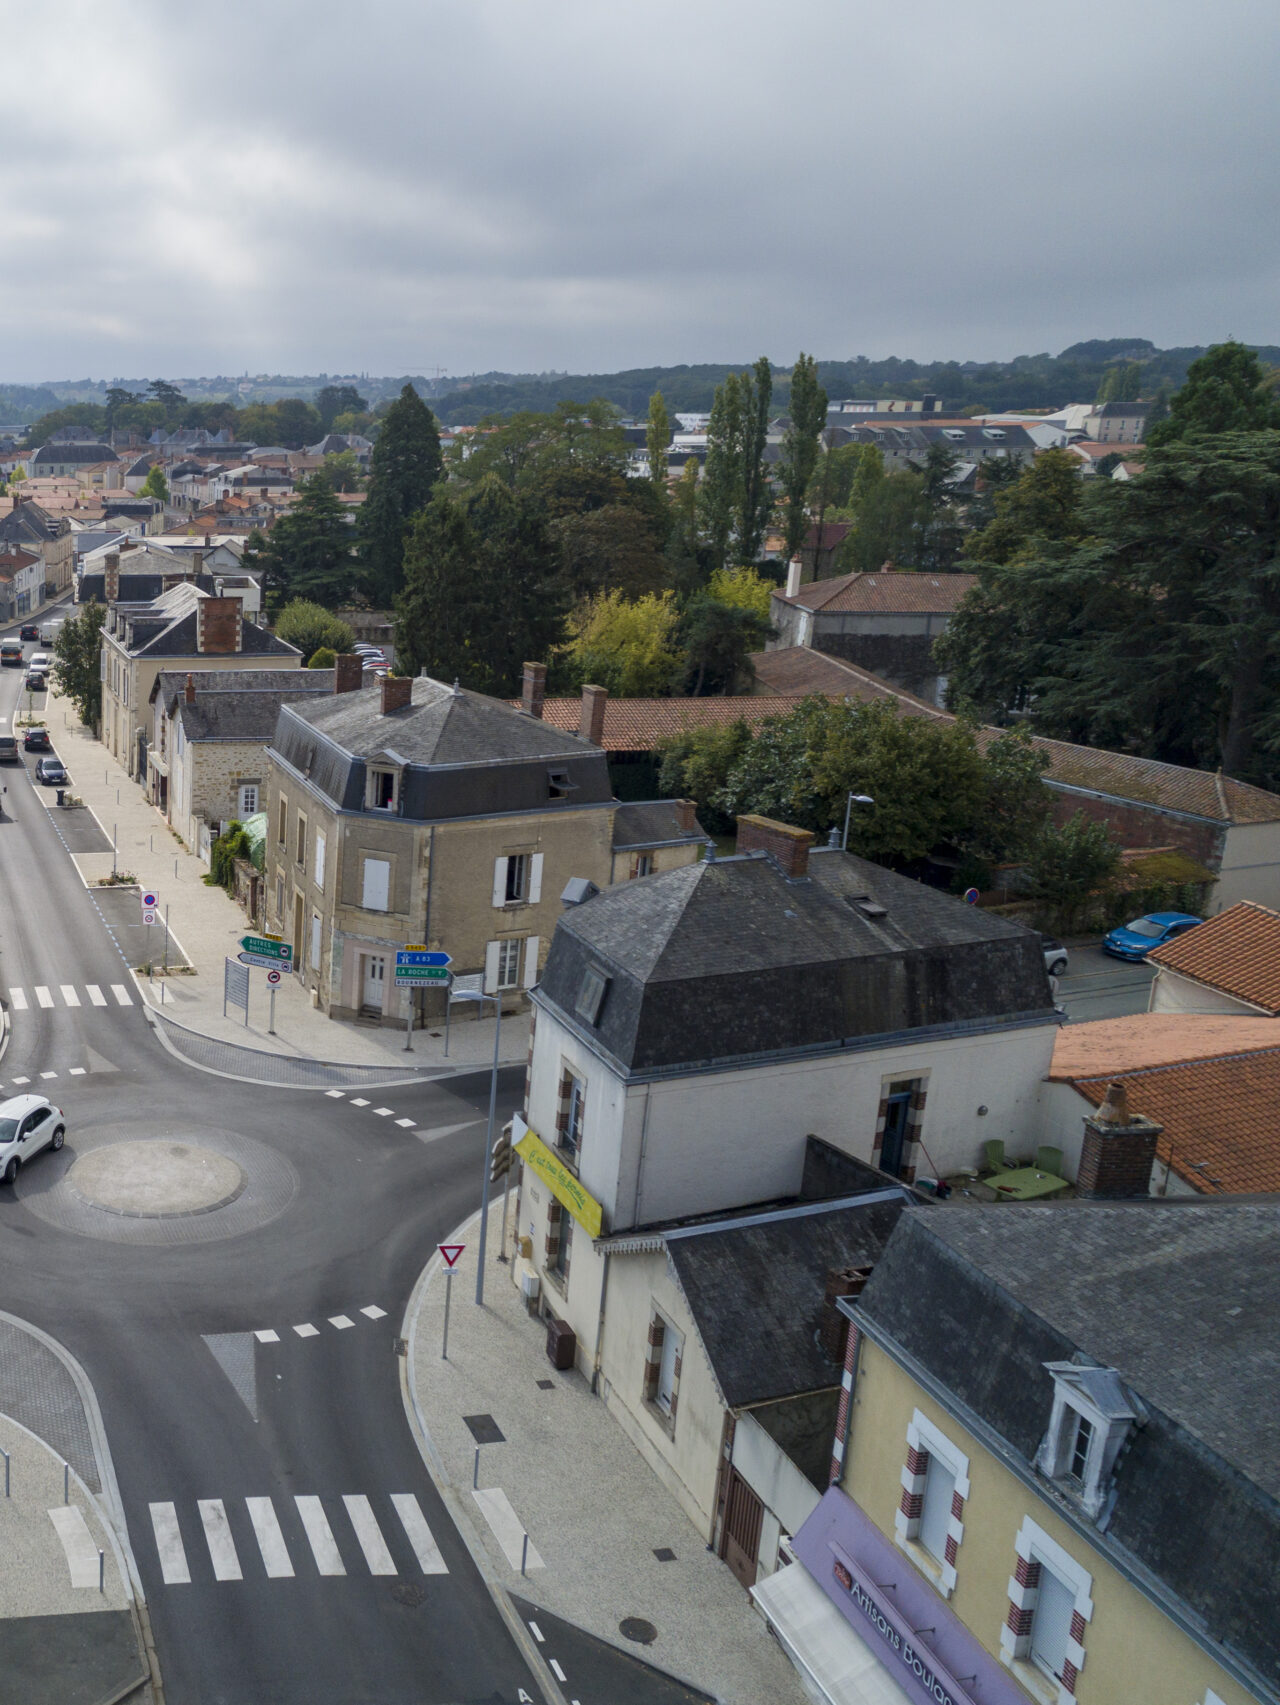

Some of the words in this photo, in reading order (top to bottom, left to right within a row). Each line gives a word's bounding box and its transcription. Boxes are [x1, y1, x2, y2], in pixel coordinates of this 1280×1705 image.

[249, 938, 271, 948] AUTRES
[249, 945, 278, 956] DIRECTIONS
[850, 1582, 900, 1650] Artisans
